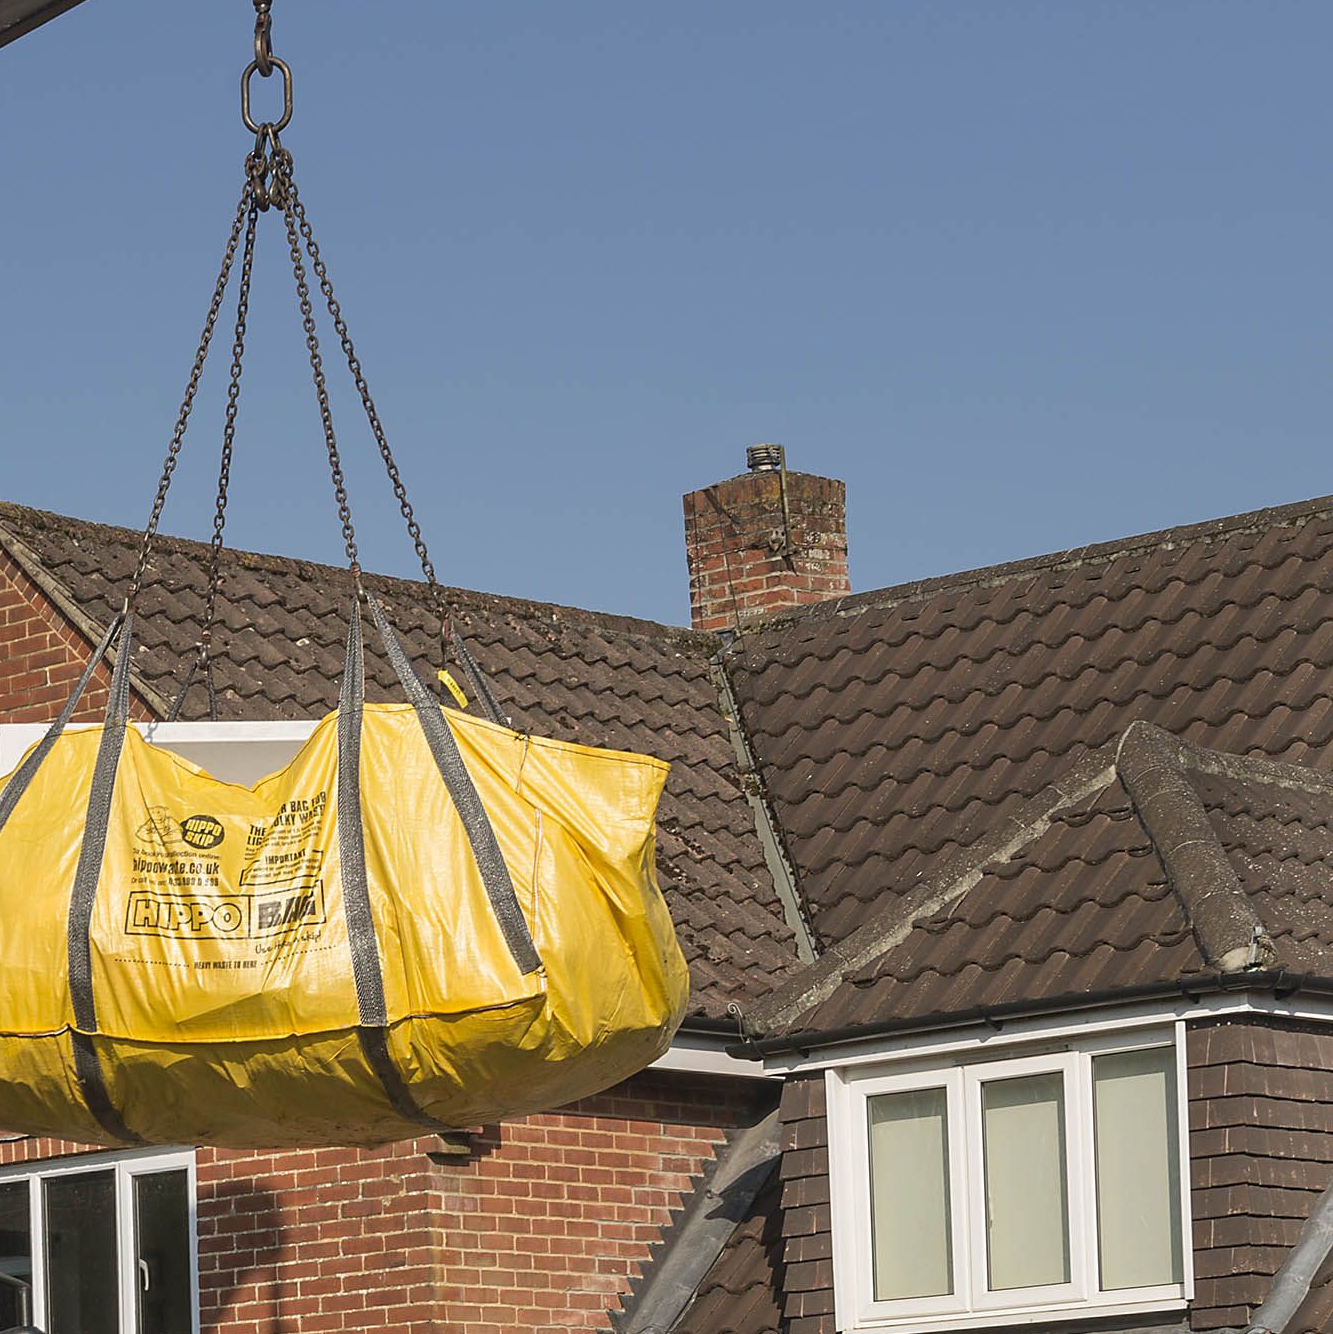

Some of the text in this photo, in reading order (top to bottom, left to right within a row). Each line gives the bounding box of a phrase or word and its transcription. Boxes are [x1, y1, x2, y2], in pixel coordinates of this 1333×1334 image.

[185, 819, 222, 837] HIPPO
[273, 813, 296, 827] ULKY
[249, 824, 267, 837] THE
[184, 831, 214, 847] SKIP
[265, 848, 306, 865] IMPORTANT
[133, 897, 242, 933] HIPPO
